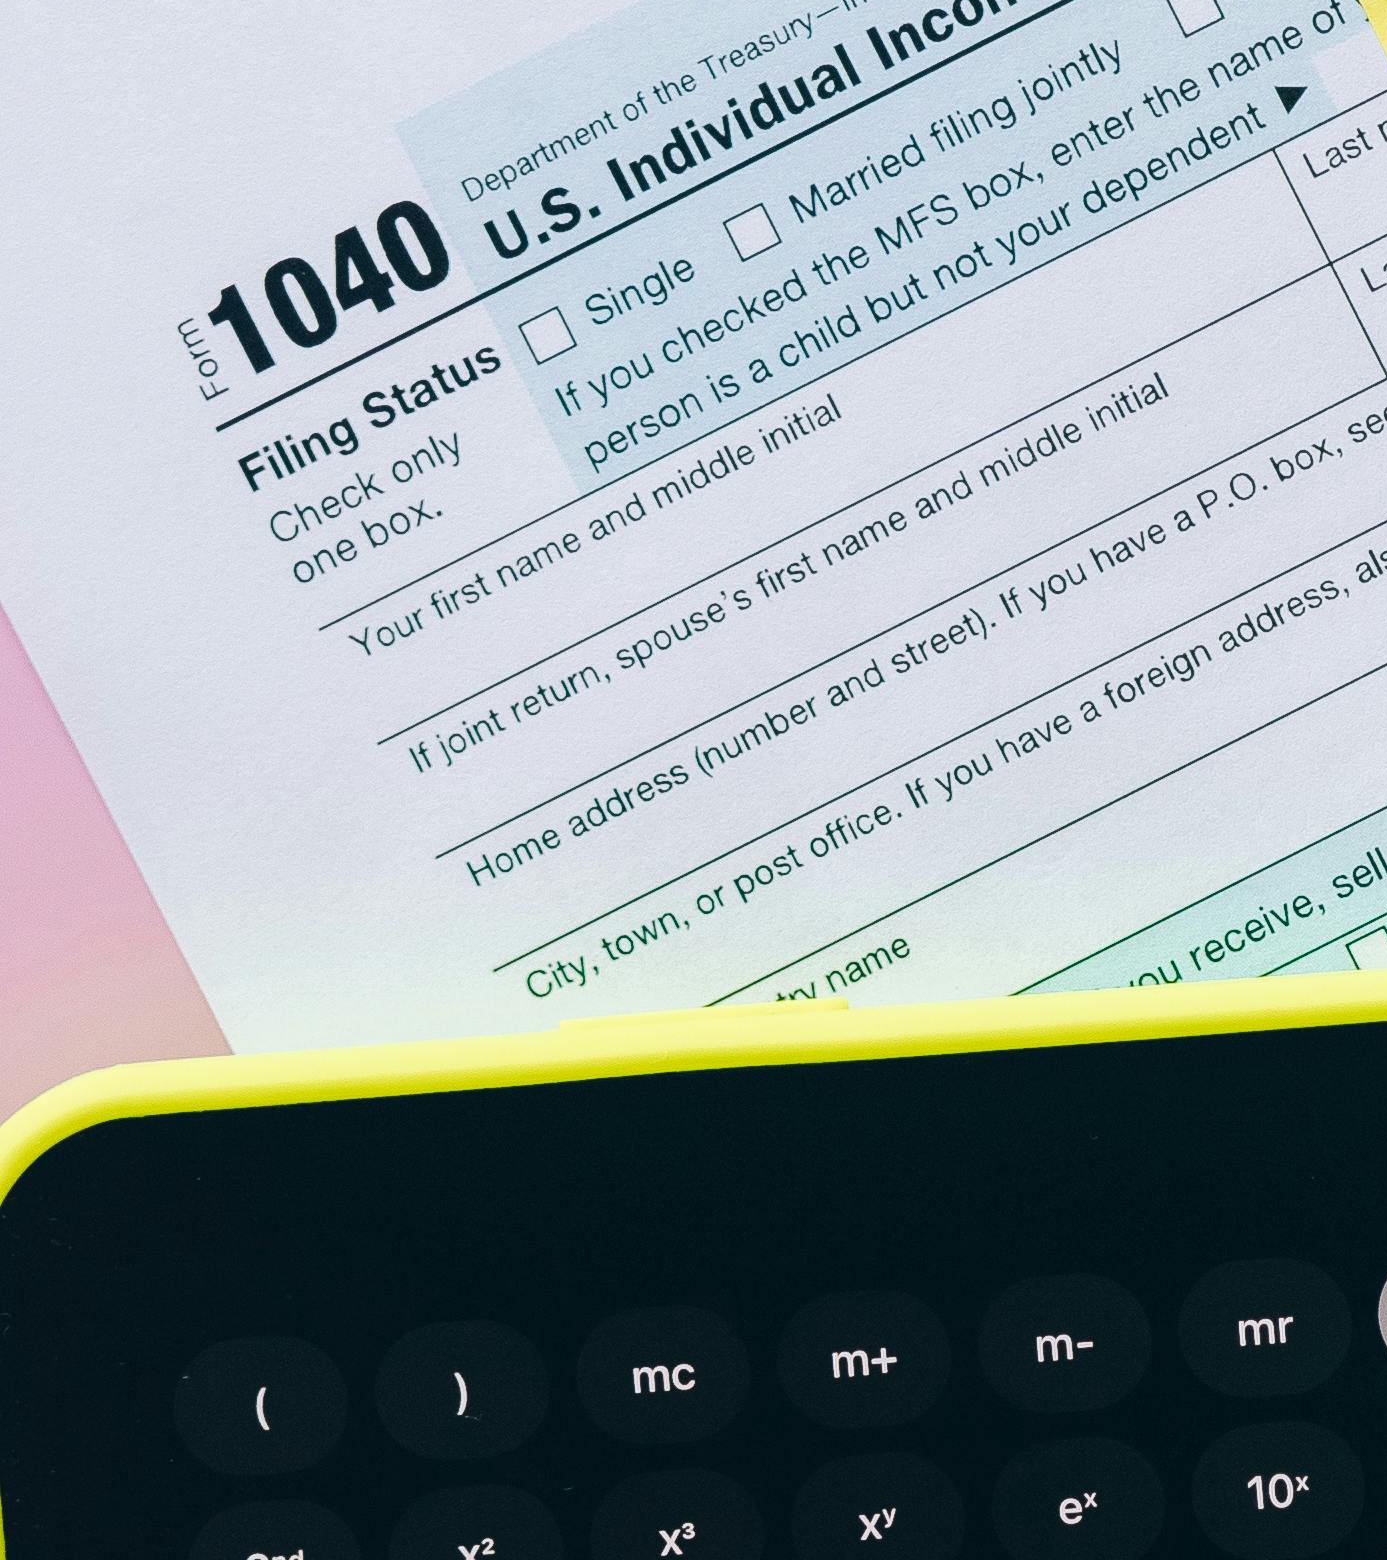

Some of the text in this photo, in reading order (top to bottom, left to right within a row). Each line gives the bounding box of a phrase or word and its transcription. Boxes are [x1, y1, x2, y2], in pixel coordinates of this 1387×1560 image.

[459, 109, 620, 204] Department
[621, 89, 650, 123] of
[651, 72, 699, 107] the
[481, 185, 603, 261] U.S.
[604, 41, 863, 203] Individual
[787, 38, 1122, 225] Married filing jointly
[206, 199, 451, 376] 1040
[553, 378, 583, 419] If
[585, 351, 657, 410] you
[660, 267, 809, 365] checked
[810, 244, 871, 287] the
[872, 192, 960, 257] MFS
[960, 159, 1046, 212] box,
[1049, 105, 1136, 168] enter
[1140, 76, 1203, 120] the
[1205, 24, 1305, 90] name
[583, 257, 697, 327] Single
[175, 316, 231, 403] Form
[235, 345, 503, 494] Filing Status
[268, 430, 462, 544] Check only
[291, 497, 445, 585] one box.
[346, 391, 844, 658] Your first name and middle initial
[407, 740, 434, 775] If
[434, 708, 508, 769] joint
[508, 664, 613, 725] return,
[754, 550, 819, 600] first
[820, 510, 909, 567] name
[913, 468, 975, 521] and
[977, 421, 1084, 489] middle
[1084, 370, 1171, 433] initial
[630, 1361, 697, 1395] mc
[830, 1345, 899, 1381] m+
[1236, 1314, 1296, 1348] mr
